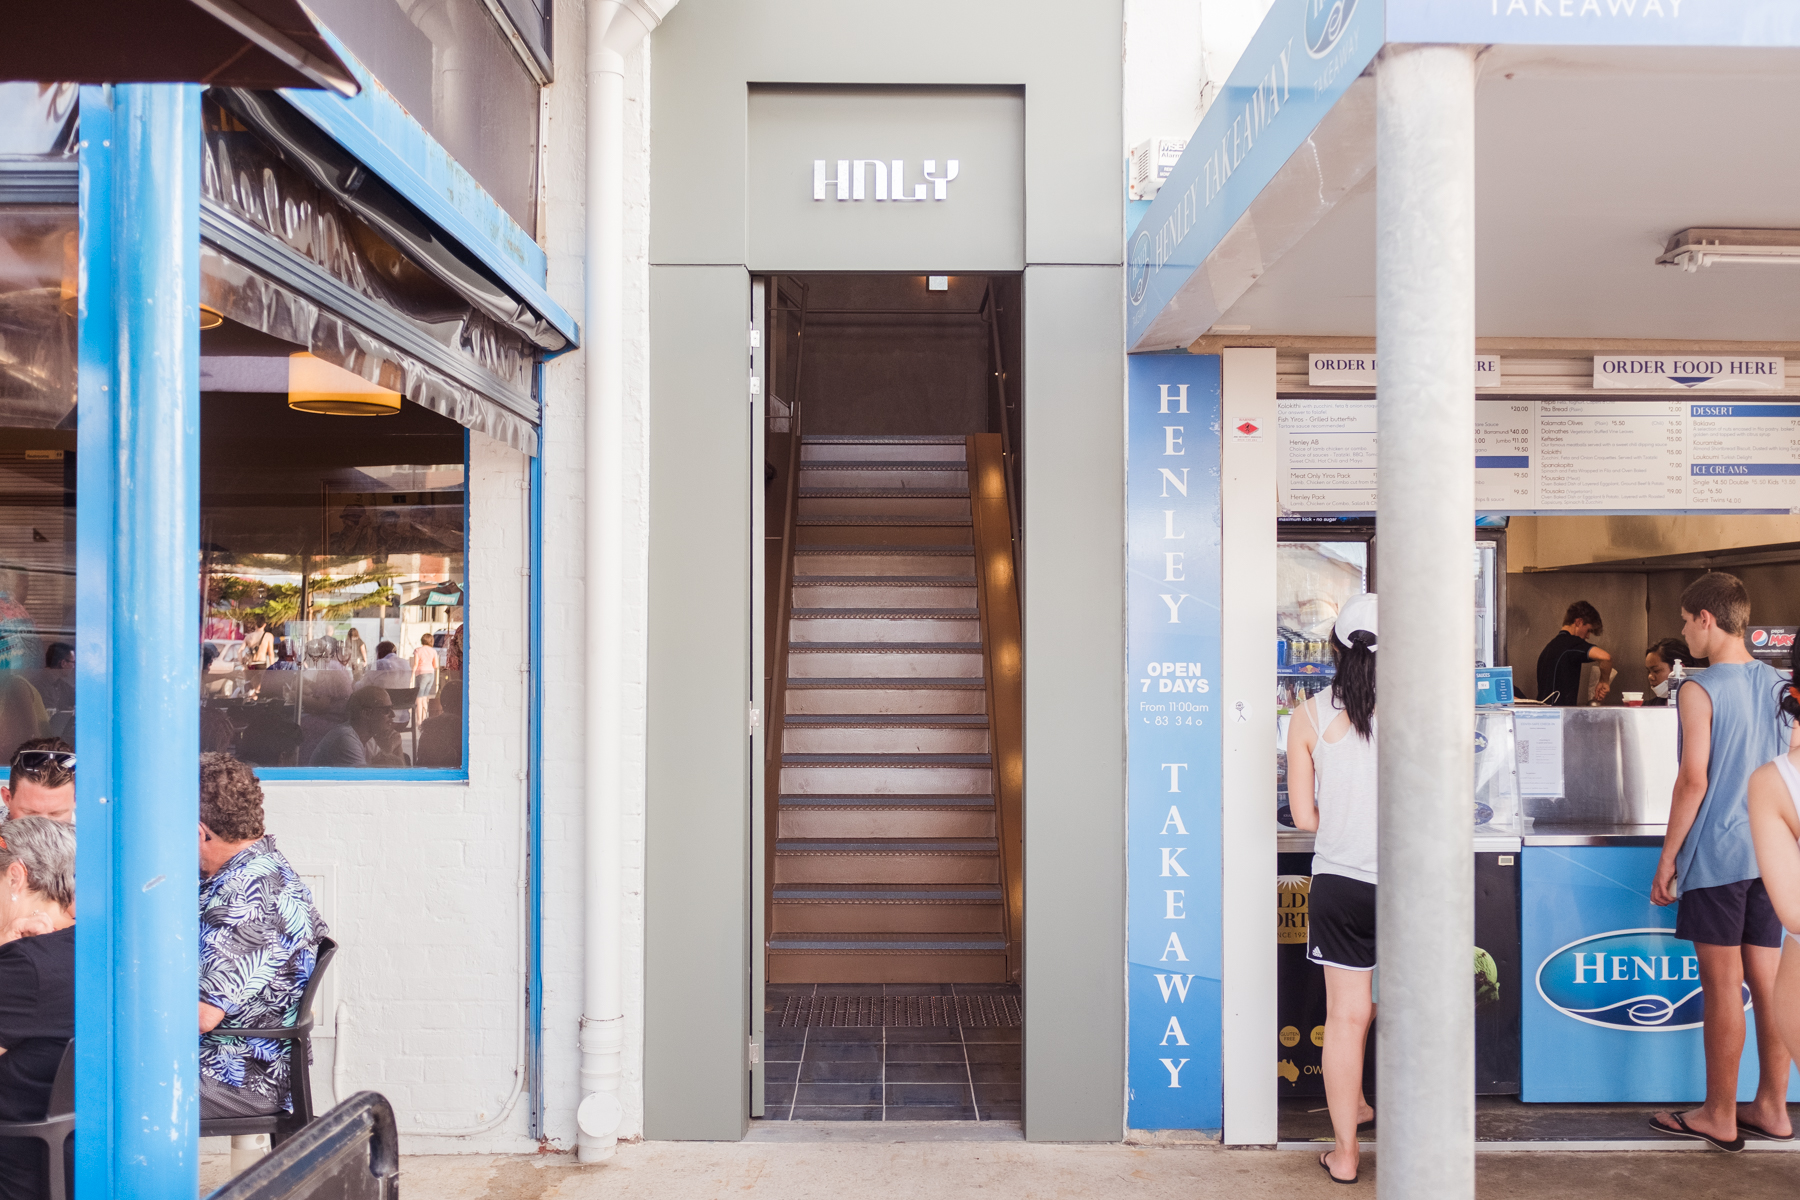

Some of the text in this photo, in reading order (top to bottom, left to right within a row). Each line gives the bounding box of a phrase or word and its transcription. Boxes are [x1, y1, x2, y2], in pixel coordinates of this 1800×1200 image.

[1154, 36, 1294, 275] HENLEY TAKEAWAY
[813, 159, 959, 201] HNLY
[1314, 359, 1366, 370] ORDER
[1602, 360, 1778, 375] ORDER FOOD HERE
[1693, 407, 1734, 415] DESSERT
[1693, 466, 1748, 474] ICE CREAMS
[1157, 384, 1190, 623] HENLEY
[1147, 662, 1201, 676] OPEN
[1140, 679, 1209, 693] 7 DAYS
[1140, 702, 1165, 711] From
[1153, 763, 1196, 1088] TAKEAWAY
